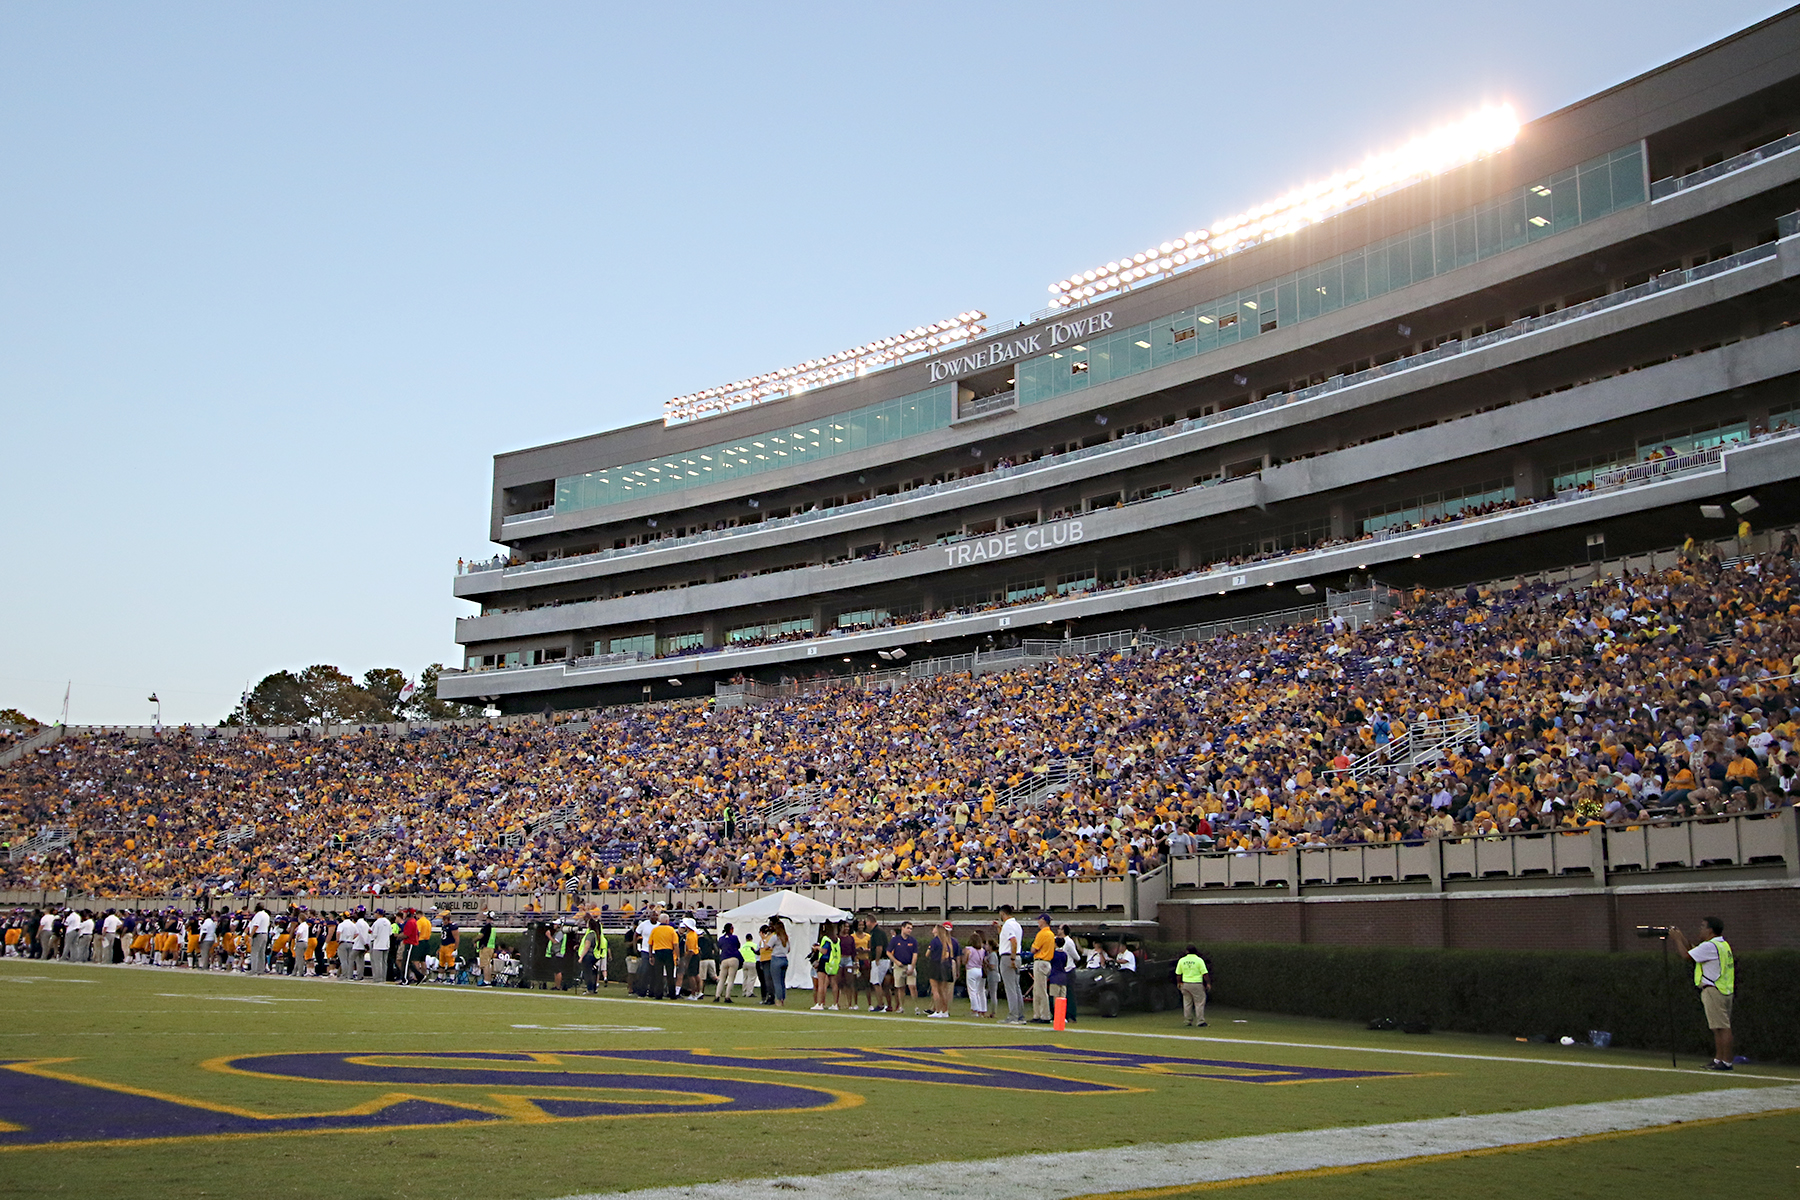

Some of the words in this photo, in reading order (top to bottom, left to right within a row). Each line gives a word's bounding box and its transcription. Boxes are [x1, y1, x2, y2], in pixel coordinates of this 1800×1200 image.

[944, 534, 1018, 566] TRADE
[1024, 520, 1084, 551] CLUB
[434, 901, 460, 910] BAGWELL
[462, 901, 479, 910] FIELD
[498, 953, 511, 961] 90
